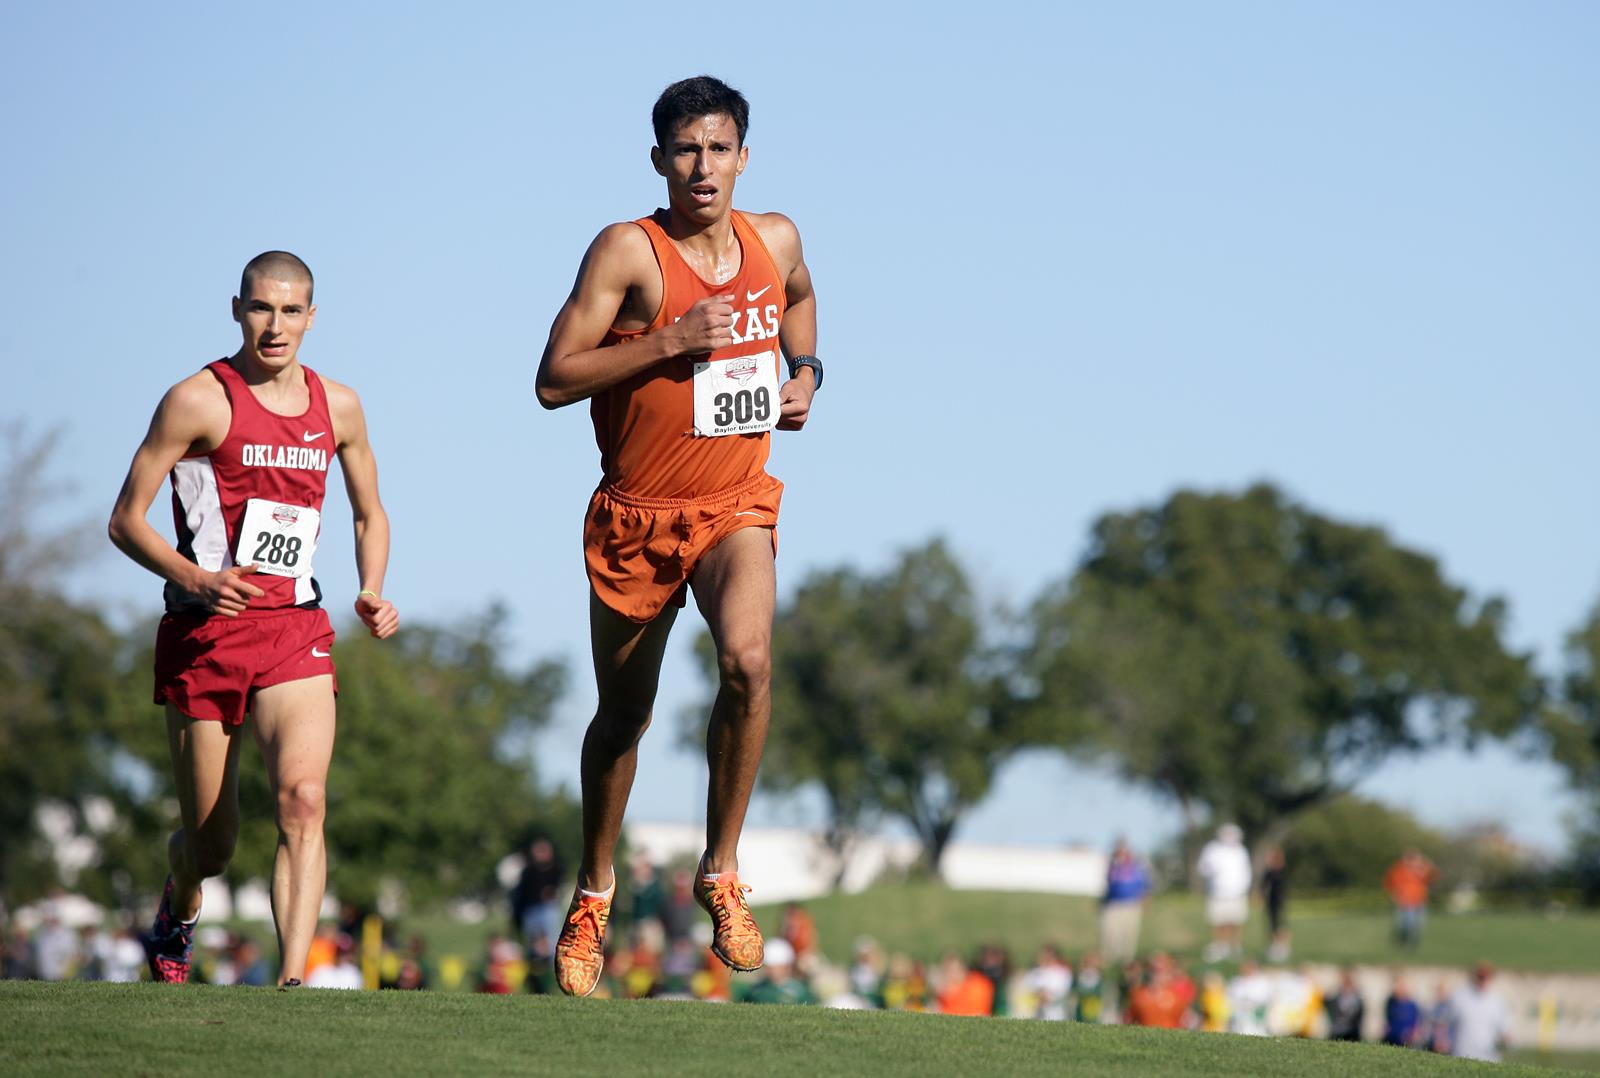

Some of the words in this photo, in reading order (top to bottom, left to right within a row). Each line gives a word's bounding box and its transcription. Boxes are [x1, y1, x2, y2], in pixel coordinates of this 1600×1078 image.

[714, 386, 771, 427] 309
[738, 422, 772, 431] University
[242, 444, 327, 472] OKLAHOMA
[252, 531, 302, 568] 288
